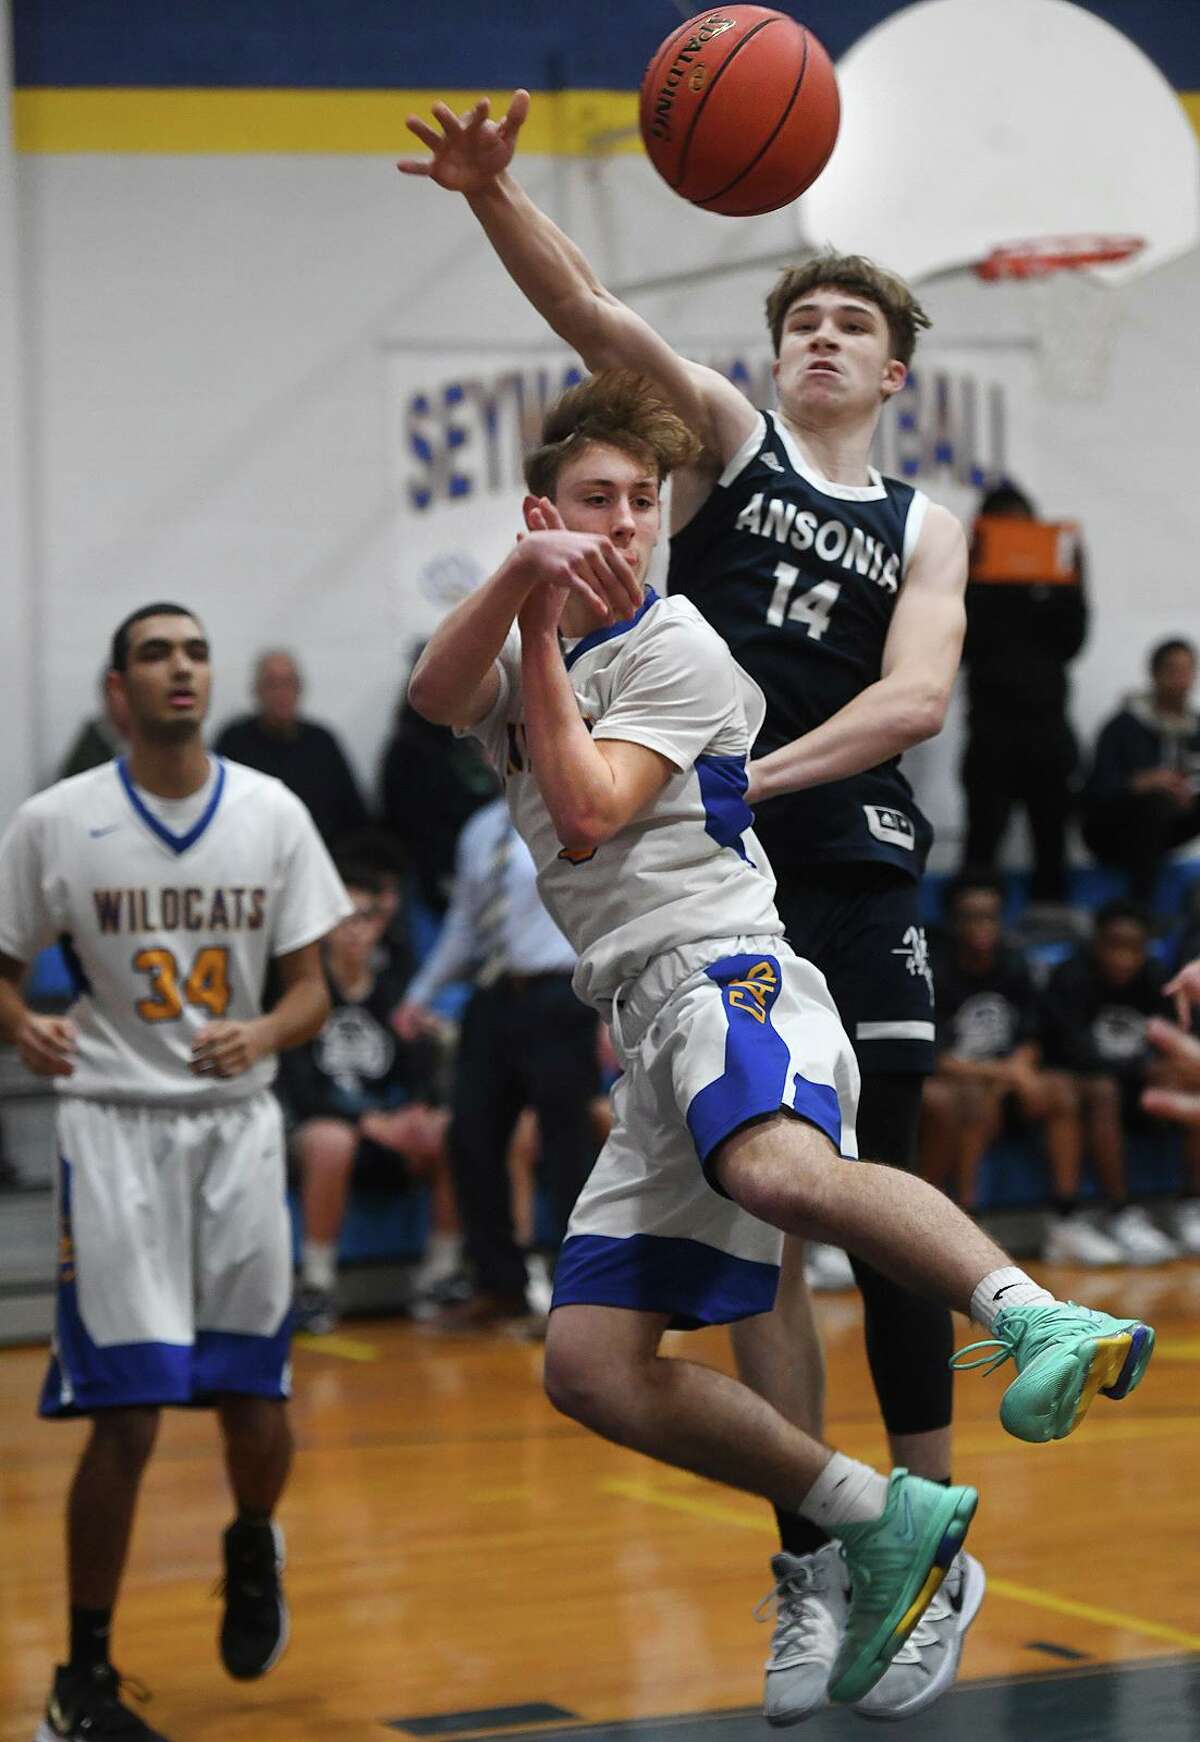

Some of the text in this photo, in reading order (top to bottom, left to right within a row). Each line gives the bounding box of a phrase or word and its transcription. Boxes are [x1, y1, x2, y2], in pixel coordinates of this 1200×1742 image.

[652, 14, 736, 143] SPALDING
[735, 492, 901, 594] ANSONIA
[766, 561, 841, 641] 14
[93, 886, 267, 935] WILDCATS
[132, 944, 234, 1025] 34
